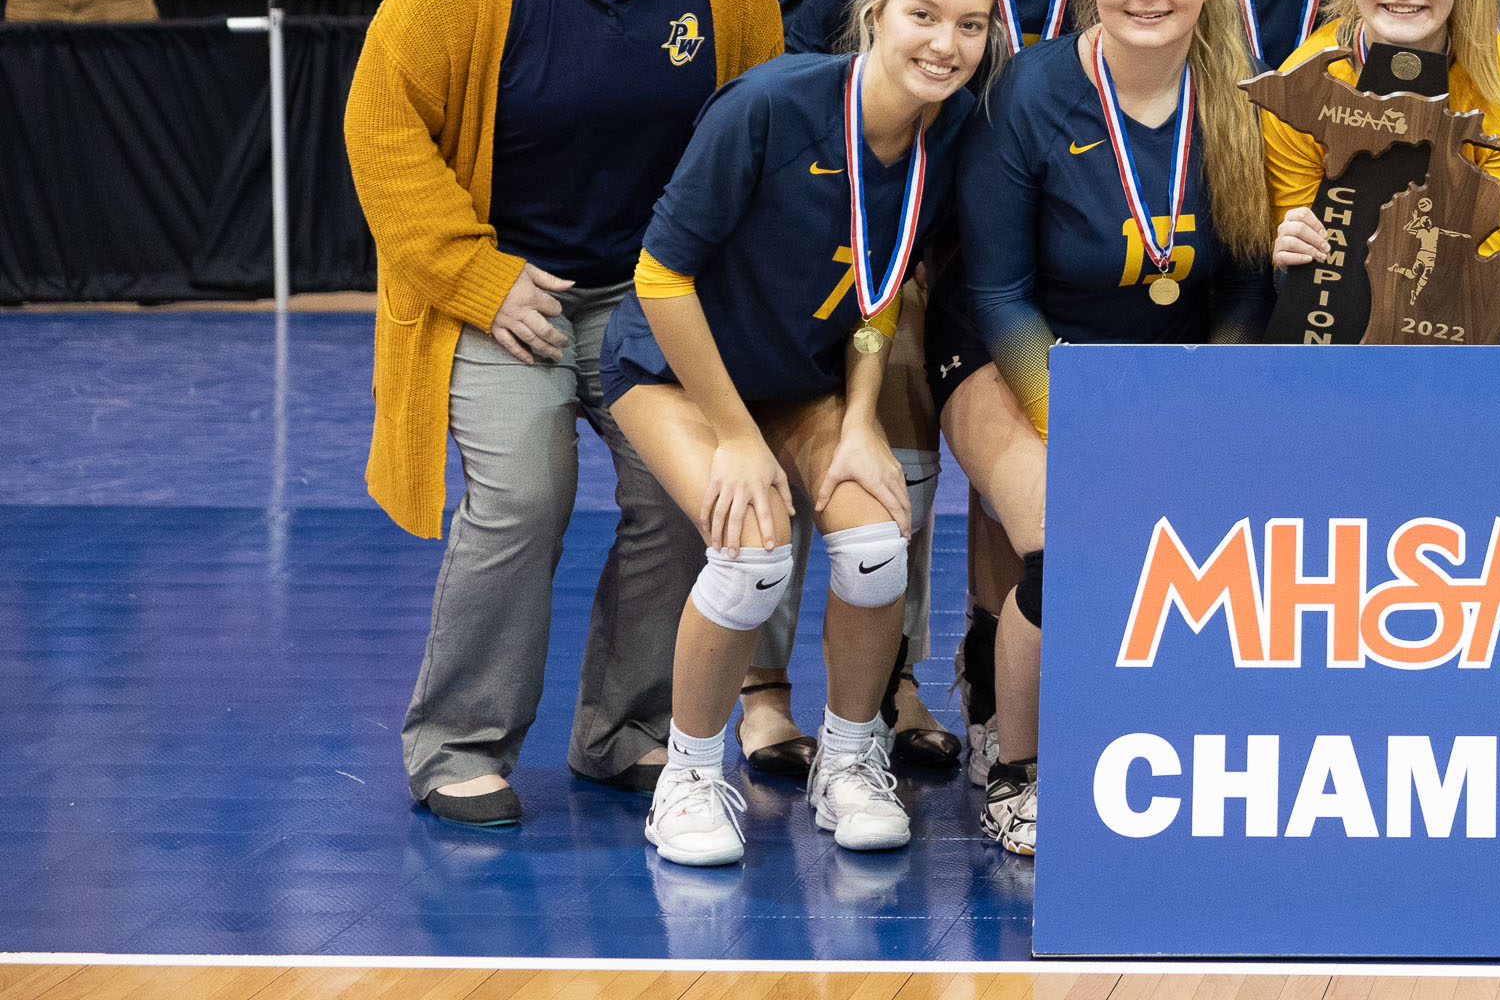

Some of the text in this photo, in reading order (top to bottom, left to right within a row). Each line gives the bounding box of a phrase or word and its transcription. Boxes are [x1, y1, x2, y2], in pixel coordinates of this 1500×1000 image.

[661, 20, 705, 62] PW
[1318, 104, 1395, 134] MHSAA
[1119, 214, 1196, 288] 15
[1303, 187, 1357, 345] CHAMPION
[812, 245, 871, 320] 7
[1401, 318, 1465, 342] 2022
